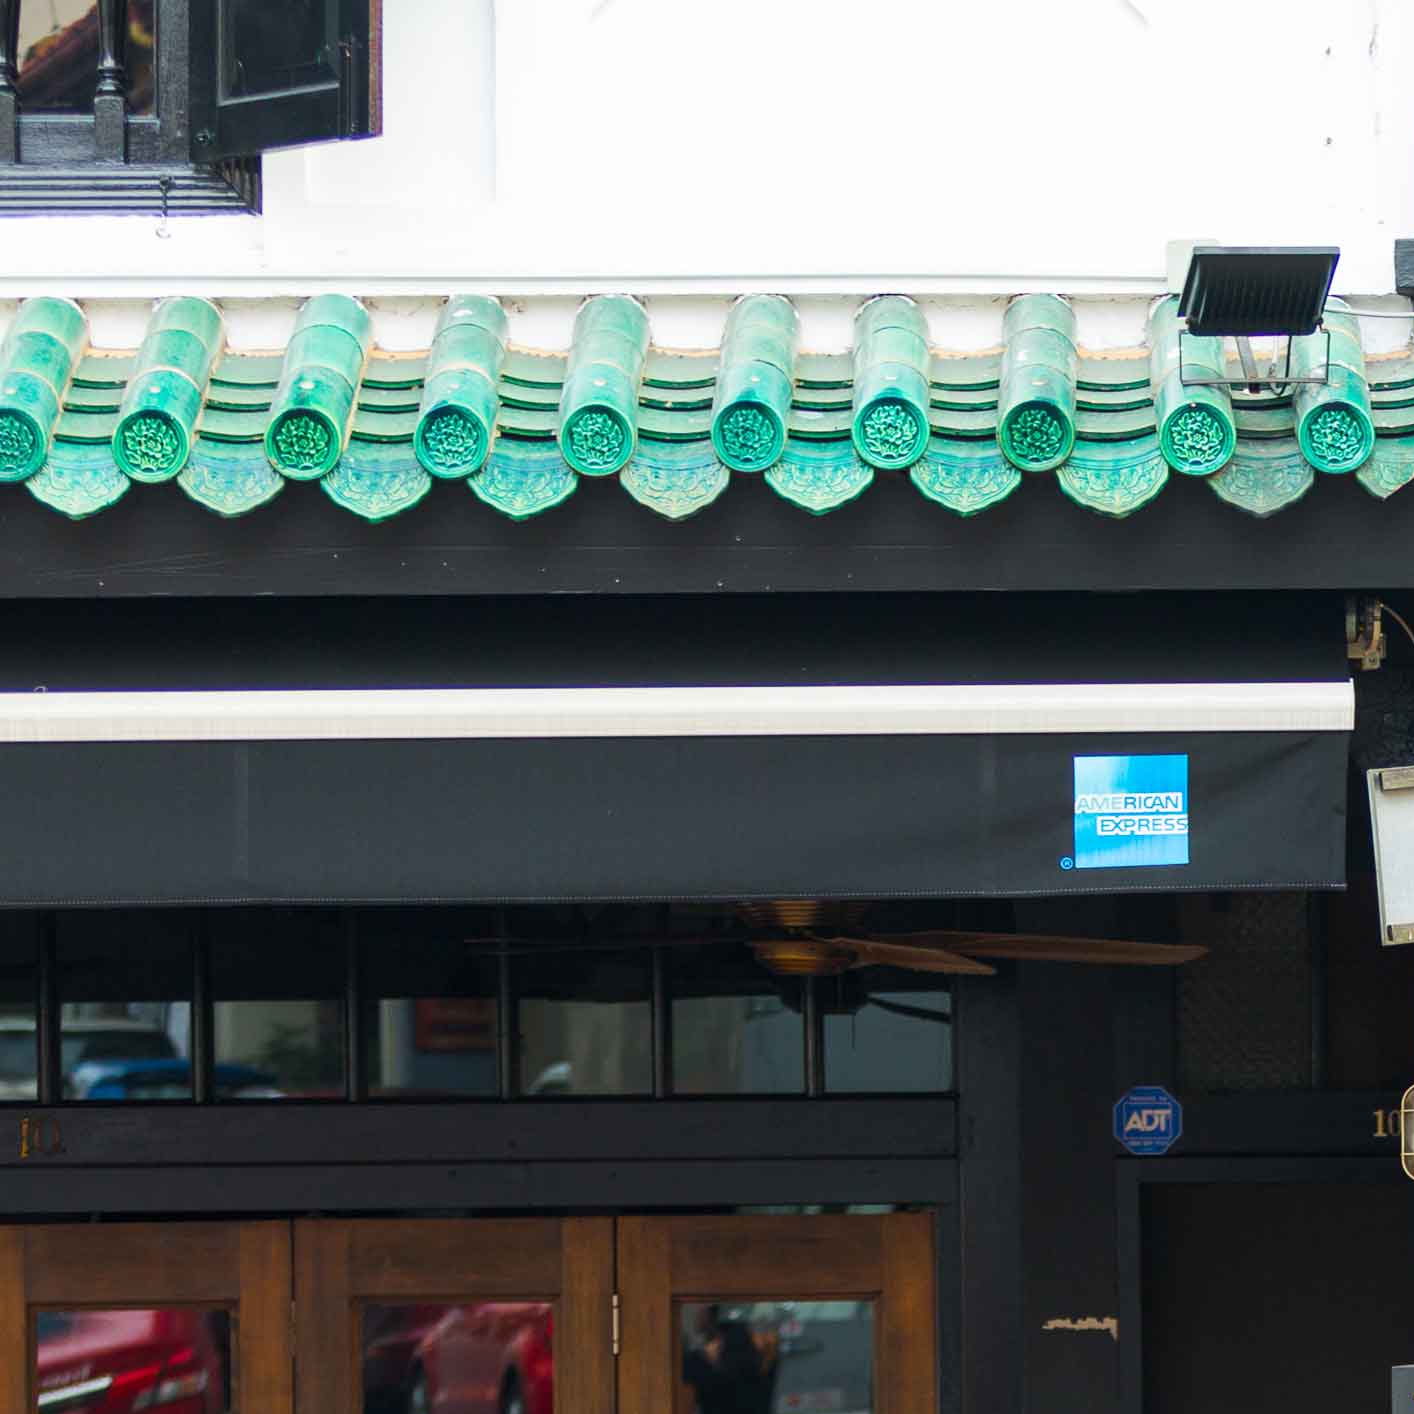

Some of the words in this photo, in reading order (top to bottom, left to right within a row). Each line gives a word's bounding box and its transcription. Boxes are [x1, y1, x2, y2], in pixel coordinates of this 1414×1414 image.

[1077, 796, 1179, 811] AMERICAN
[1100, 818, 1189, 833] EXPRESS
[1125, 1109, 1171, 1131] ADT
